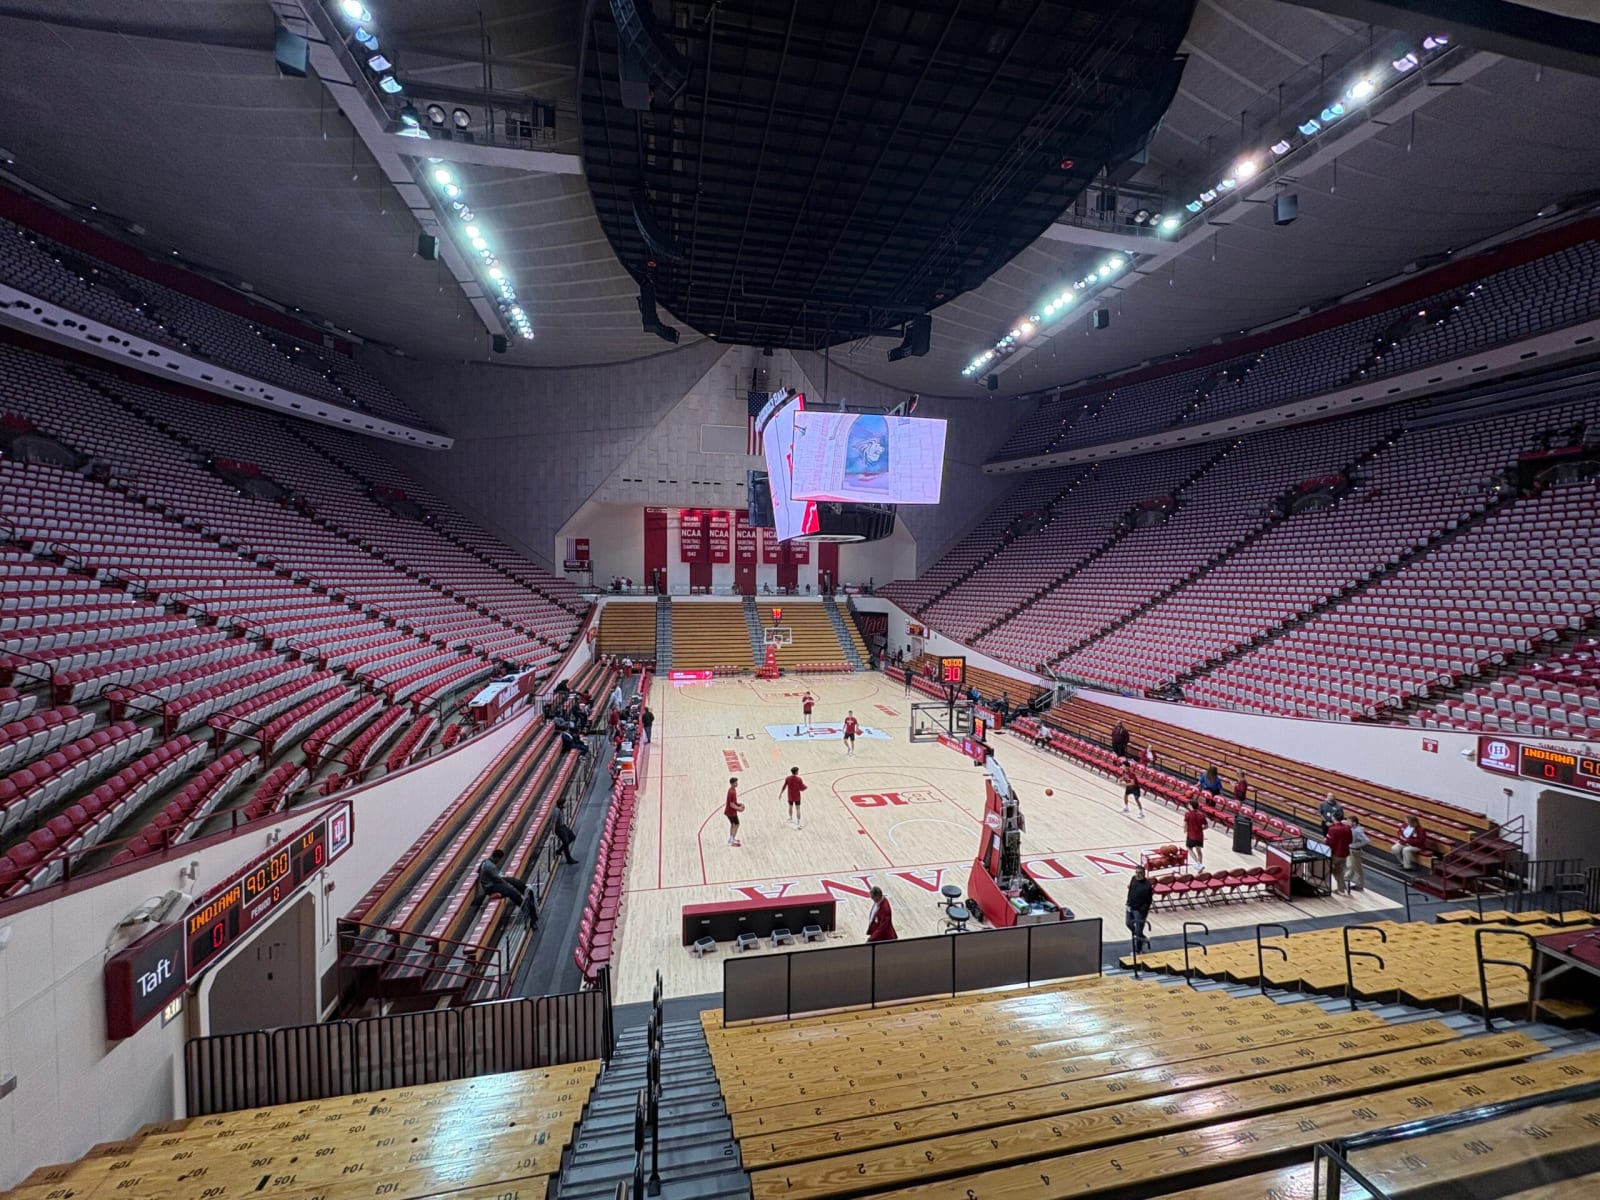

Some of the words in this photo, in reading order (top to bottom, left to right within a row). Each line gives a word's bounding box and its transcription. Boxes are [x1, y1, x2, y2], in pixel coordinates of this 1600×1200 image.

[682, 529, 702, 537] NCAA
[942, 659, 962, 667] 90:00
[945, 667, 960, 681] 30
[1524, 748, 1575, 765] INDIANA
[1544, 764, 1555, 778] 0
[302, 832, 314, 848] LU
[315, 845, 322, 864] 0
[246, 852, 288, 894] 90:00
[272, 886, 280, 902] 0
[190, 885, 240, 934] INDIANA
[250, 897, 271, 919] PERIOD
[213, 923, 223, 948] 0
[138, 958, 172, 998] Taft
[1354, 1016, 1371, 1024] 101
[1421, 1027, 1439, 1035] 101
[1237, 1035, 1253, 1043] 104
[1380, 1033, 1399, 1041] 102
[1195, 1043, 1214, 1051] 105
[1339, 1041, 1358, 1049] 103
[1504, 1040, 1524, 1048] 101
[1296, 1047, 1315, 1056] 104
[1251, 1056, 1270, 1065] 105
[1415, 1057, 1436, 1066] 103
[1063, 1065, 1080, 1073] 108
[1368, 1065, 1390, 1075] 104
[1558, 1065, 1585, 1076] 102
[1320, 1075, 1342, 1085] 105
[1511, 1075, 1536, 1086] 103
[1107, 1082, 1127, 1092] 108
[1270, 1083, 1292, 1094] 106
[1461, 1085, 1485, 1097] 104
[557, 1094, 571, 1102] 101
[1061, 1092, 1069, 1100] 6
[1008, 1102, 1016, 1110] 5
[1407, 1096, 1432, 1107] 105
[1163, 1104, 1184, 1115] 108
[1352, 1108, 1377, 1120] 106
[952, 1112, 958, 1120] 4
[1112, 1116, 1121, 1125] 6
[759, 1118, 764, 1126] 1
[894, 1122, 902, 1130] 3
[1296, 1120, 1320, 1132] 107
[217, 1130, 235, 1138] 108
[349, 1125, 366, 1133] 105
[1052, 1126, 1062, 1137] 5
[1524, 1126, 1553, 1140] 105
[833, 1132, 841, 1141] 2
[232, 1142, 253, 1151] 107
[376, 1138, 396, 1146] 104
[991, 1139, 998, 1149] 4
[315, 1148, 335, 1157] 105
[723, 1144, 733, 1156] 10
[771, 1143, 776, 1152] 1
[1464, 1140, 1493, 1155] 106
[172, 1151, 193, 1160] 108
[924, 1151, 934, 1162] 3
[110, 1160, 131, 1170] 109
[252, 1158, 274, 1168] 106
[517, 1158, 537, 1168] 101
[1110, 1160, 1122, 1171] 5
[188, 1168, 208, 1177] 107
[343, 1164, 364, 1174] 104
[857, 1163, 866, 1174] 2
[117, 1178, 141, 1188] 108
[274, 1175, 296, 1186] 105
[787, 1178, 794, 1188] 1
[1040, 1174, 1050, 1185] 4
[201, 1186, 226, 1198] 106
[376, 1183, 399, 1195] 103
[966, 1189, 977, 1200] 3
